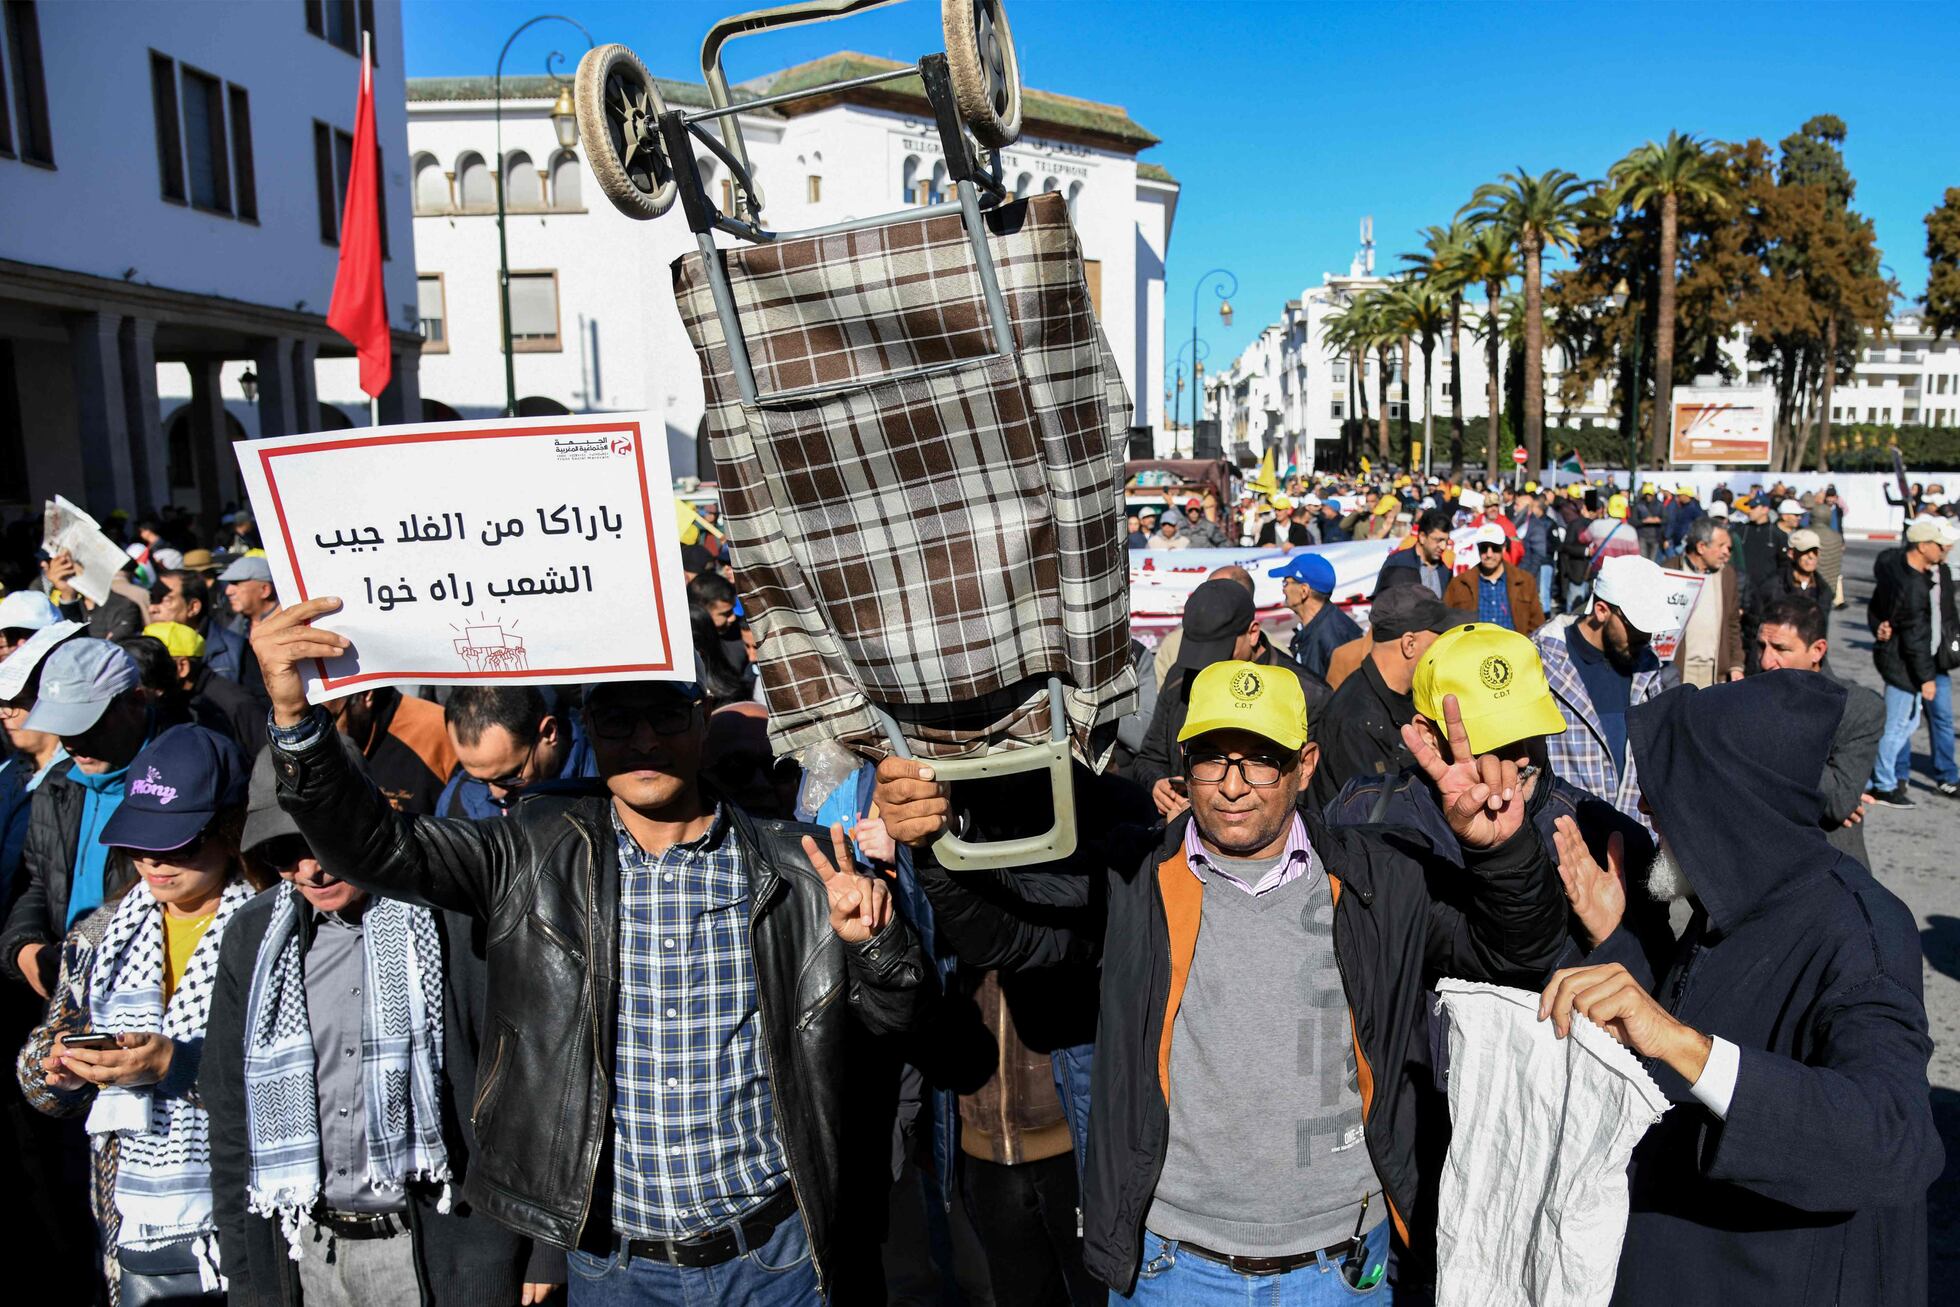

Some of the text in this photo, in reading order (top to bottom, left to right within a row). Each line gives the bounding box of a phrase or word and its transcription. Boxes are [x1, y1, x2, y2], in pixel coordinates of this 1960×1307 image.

[314, 503, 622, 555] باراكا من الغلا جيب
[363, 566, 593, 612] الشعب راه خوا
[1494, 690, 1511, 700] C.D.T
